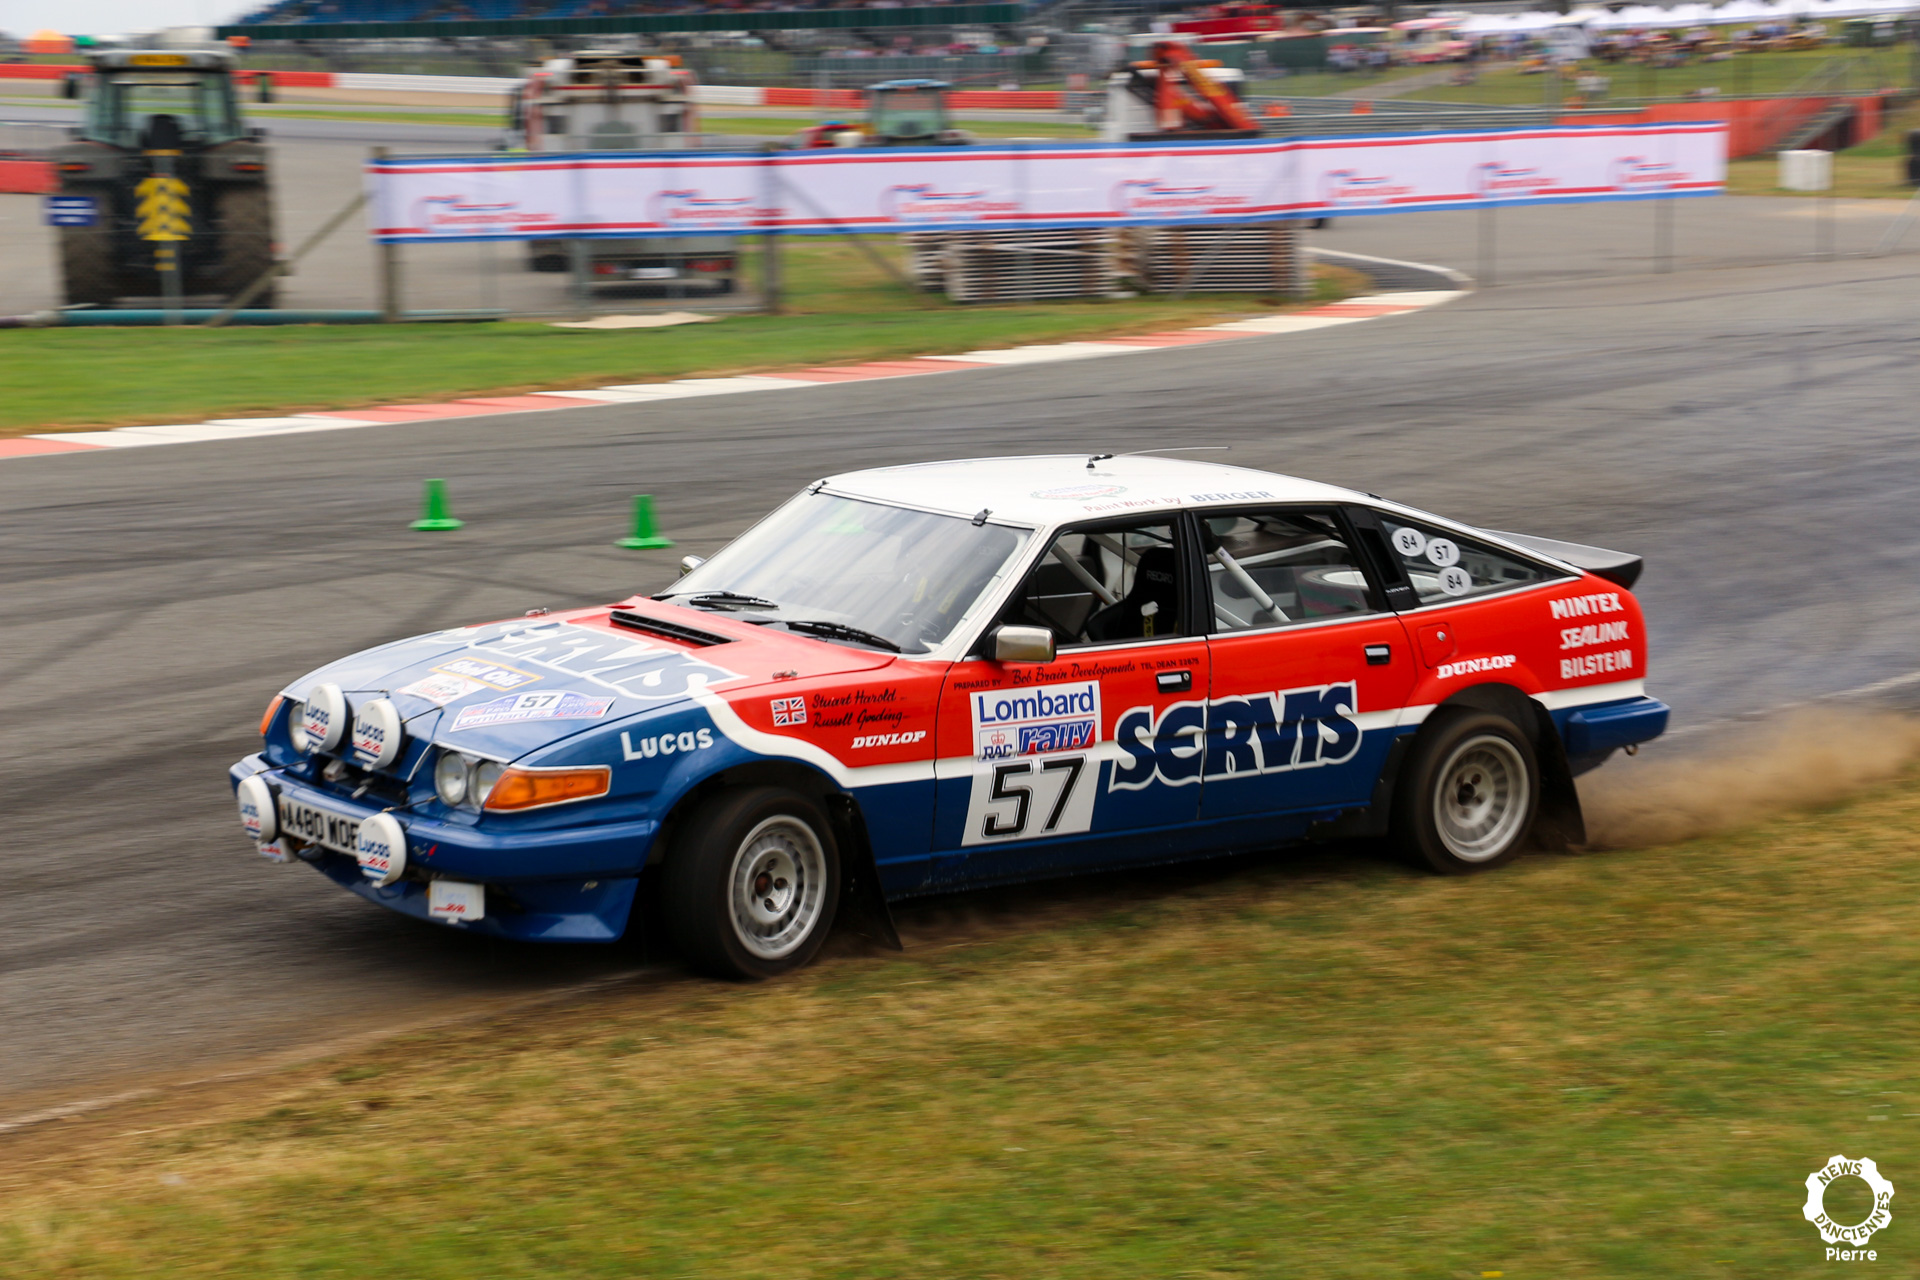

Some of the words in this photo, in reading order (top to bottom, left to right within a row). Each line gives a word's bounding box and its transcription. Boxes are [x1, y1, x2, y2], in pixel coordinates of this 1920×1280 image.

[1122, 498, 1156, 509] Work
[1164, 495, 1181, 505] by
[1190, 490, 1275, 502] BERGER
[1402, 534, 1418, 549] 84
[1435, 545, 1450, 560] 57
[1446, 574, 1463, 589] 84
[1549, 593, 1624, 619] MINTEX
[1559, 621, 1630, 649] SEALINK
[953, 680, 990, 691] PREPARED
[992, 679, 1002, 687] BY
[1012, 669, 1032, 685] Bob
[1035, 666, 1067, 683] Brain
[1071, 661, 1136, 679] Developments
[1437, 655, 1517, 679] DUNLOP
[1560, 650, 1633, 679] BILSTEIN
[305, 698, 330, 725] Lucas
[520, 695, 557, 709] 57
[811, 693, 851, 709] Stuart
[854, 688, 897, 704] Harold
[978, 685, 1095, 724] Lombard
[355, 714, 386, 743] Lucas
[813, 712, 853, 729] Russell
[857, 709, 903, 731] Gooding
[620, 727, 714, 762] Lucas
[851, 730, 927, 749] DUNLOP
[1018, 721, 1094, 755] rally
[1108, 680, 1363, 793] SERVIS
[982, 743, 1013, 760] RAC
[981, 756, 1087, 839] 57
[286, 802, 324, 840] A480
[358, 832, 391, 859] Lucas
